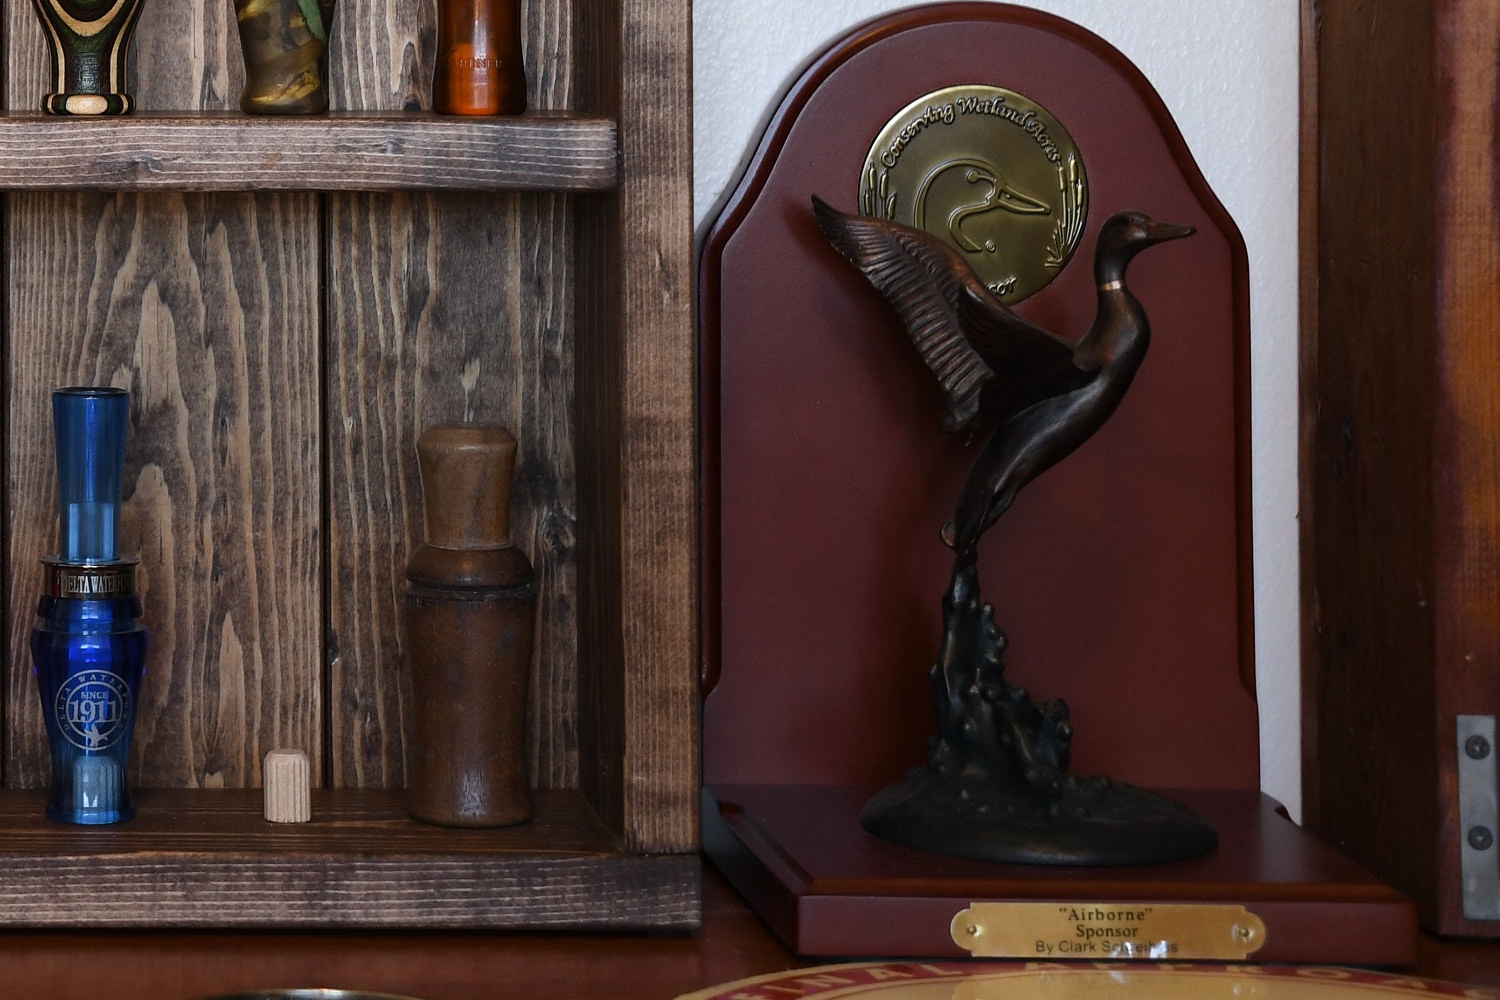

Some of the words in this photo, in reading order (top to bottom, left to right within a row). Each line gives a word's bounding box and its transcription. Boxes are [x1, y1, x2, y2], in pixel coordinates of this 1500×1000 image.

[881, 104, 954, 168] Conserving
[957, 96, 1035, 128] Wetland
[1025, 120, 1062, 167] Acres
[80, 691, 109, 699] SINCE
[68, 699, 118, 723] 1911
[1059, 907, 1153, 921] "Airborne"
[1075, 924, 1139, 938] Sponsor
[1036, 940, 1055, 955] By
[1059, 940, 1097, 953] Clark
